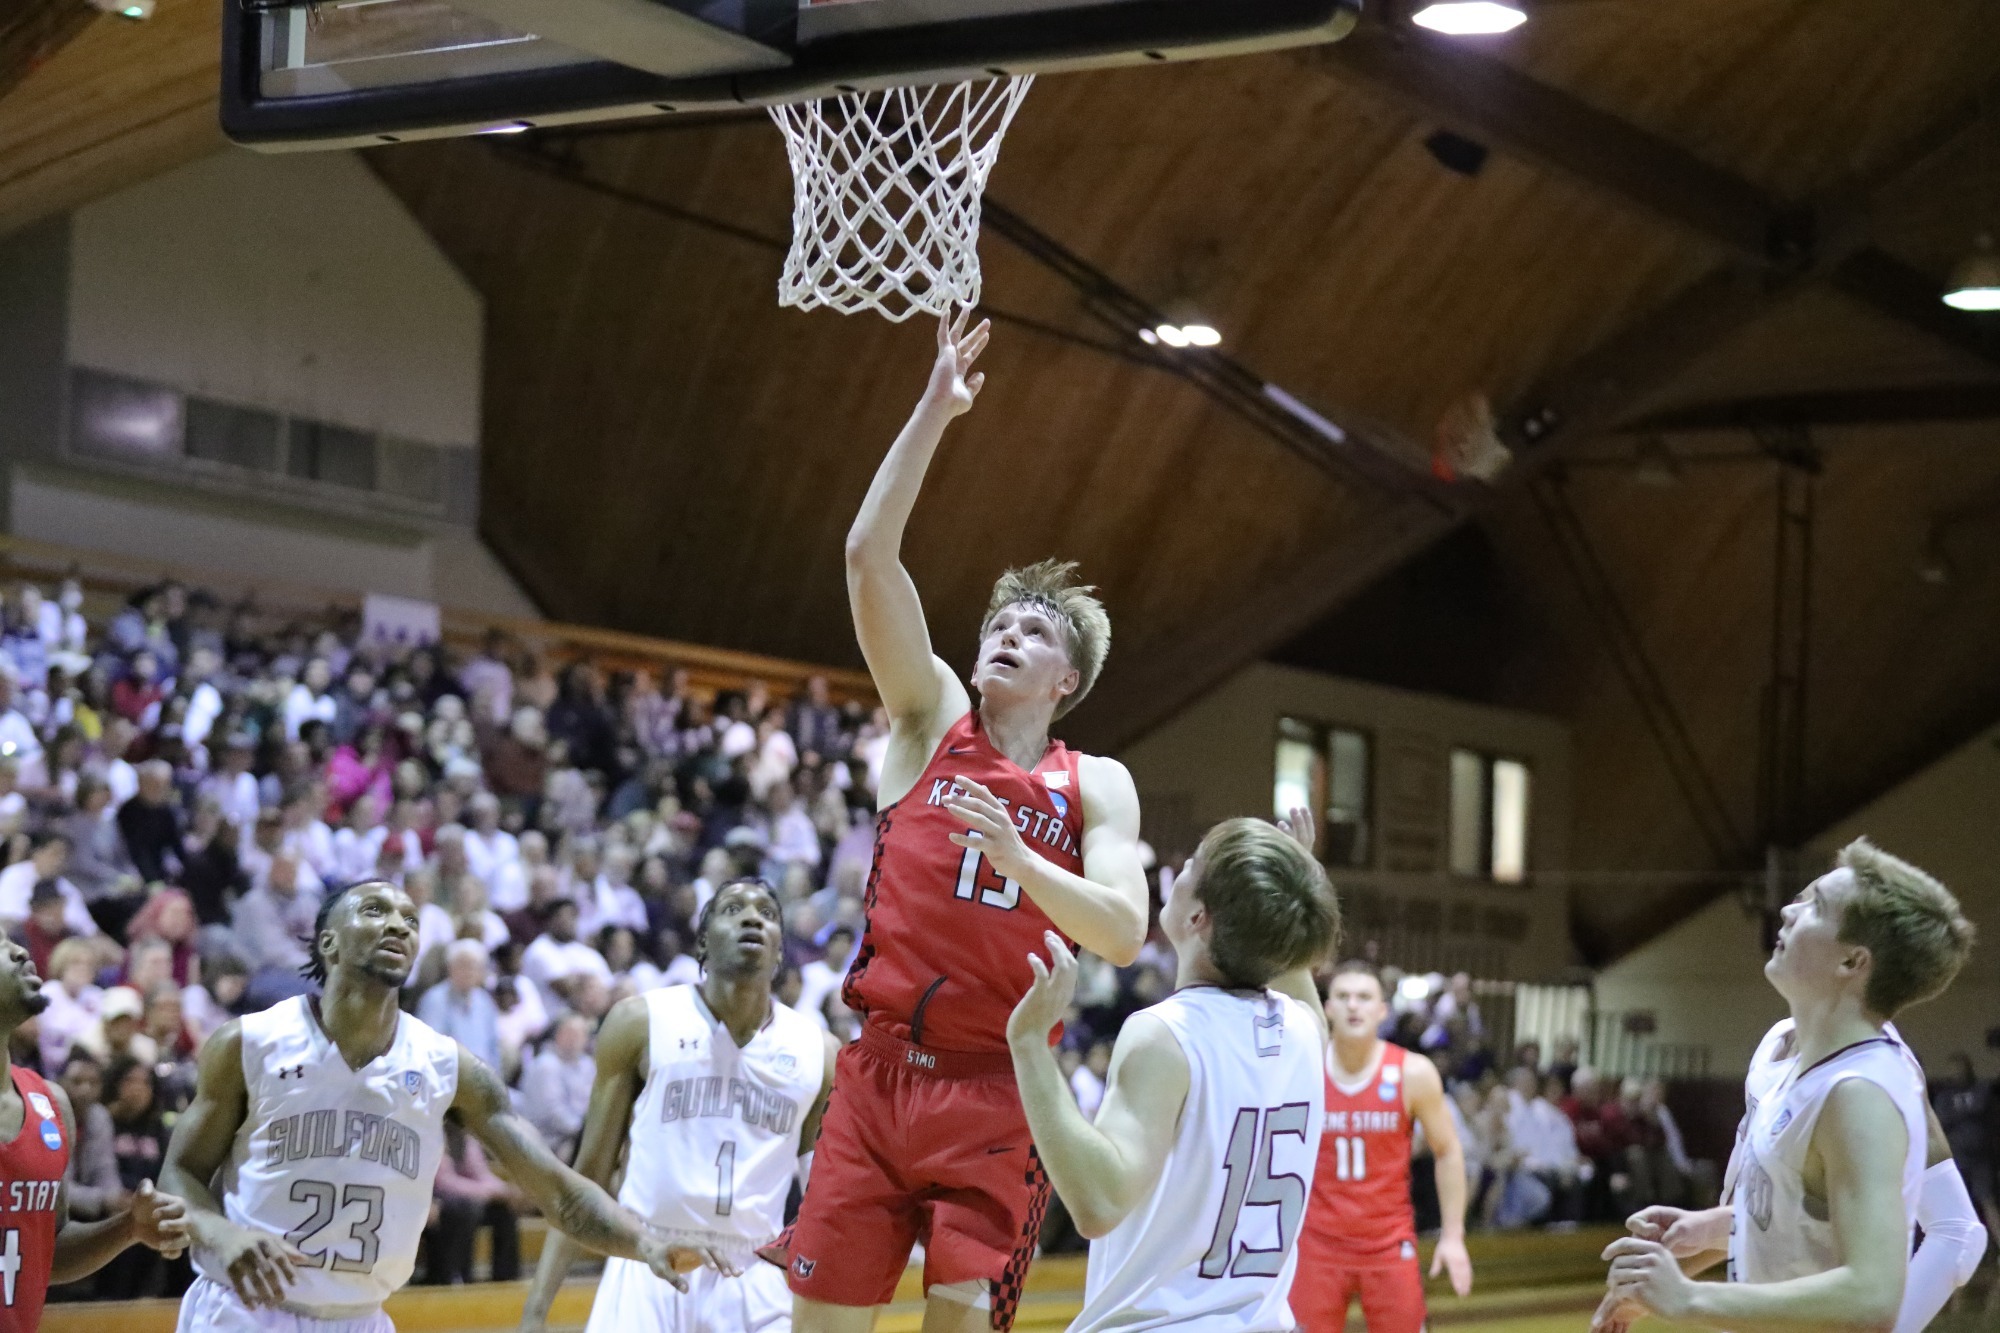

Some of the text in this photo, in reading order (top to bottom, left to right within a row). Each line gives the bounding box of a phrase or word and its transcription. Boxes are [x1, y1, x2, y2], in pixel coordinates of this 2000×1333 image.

[661, 1075, 799, 1136] GUILFORD
[1351, 1111, 1400, 1132] STATE
[266, 1109, 421, 1180] GUILFORD
[1334, 1136, 1366, 1181] 11
[9, 1180, 61, 1212] STAT
[715, 1140, 736, 1216] 1
[1198, 1101, 1310, 1279] 15
[283, 1179, 386, 1274] 23
